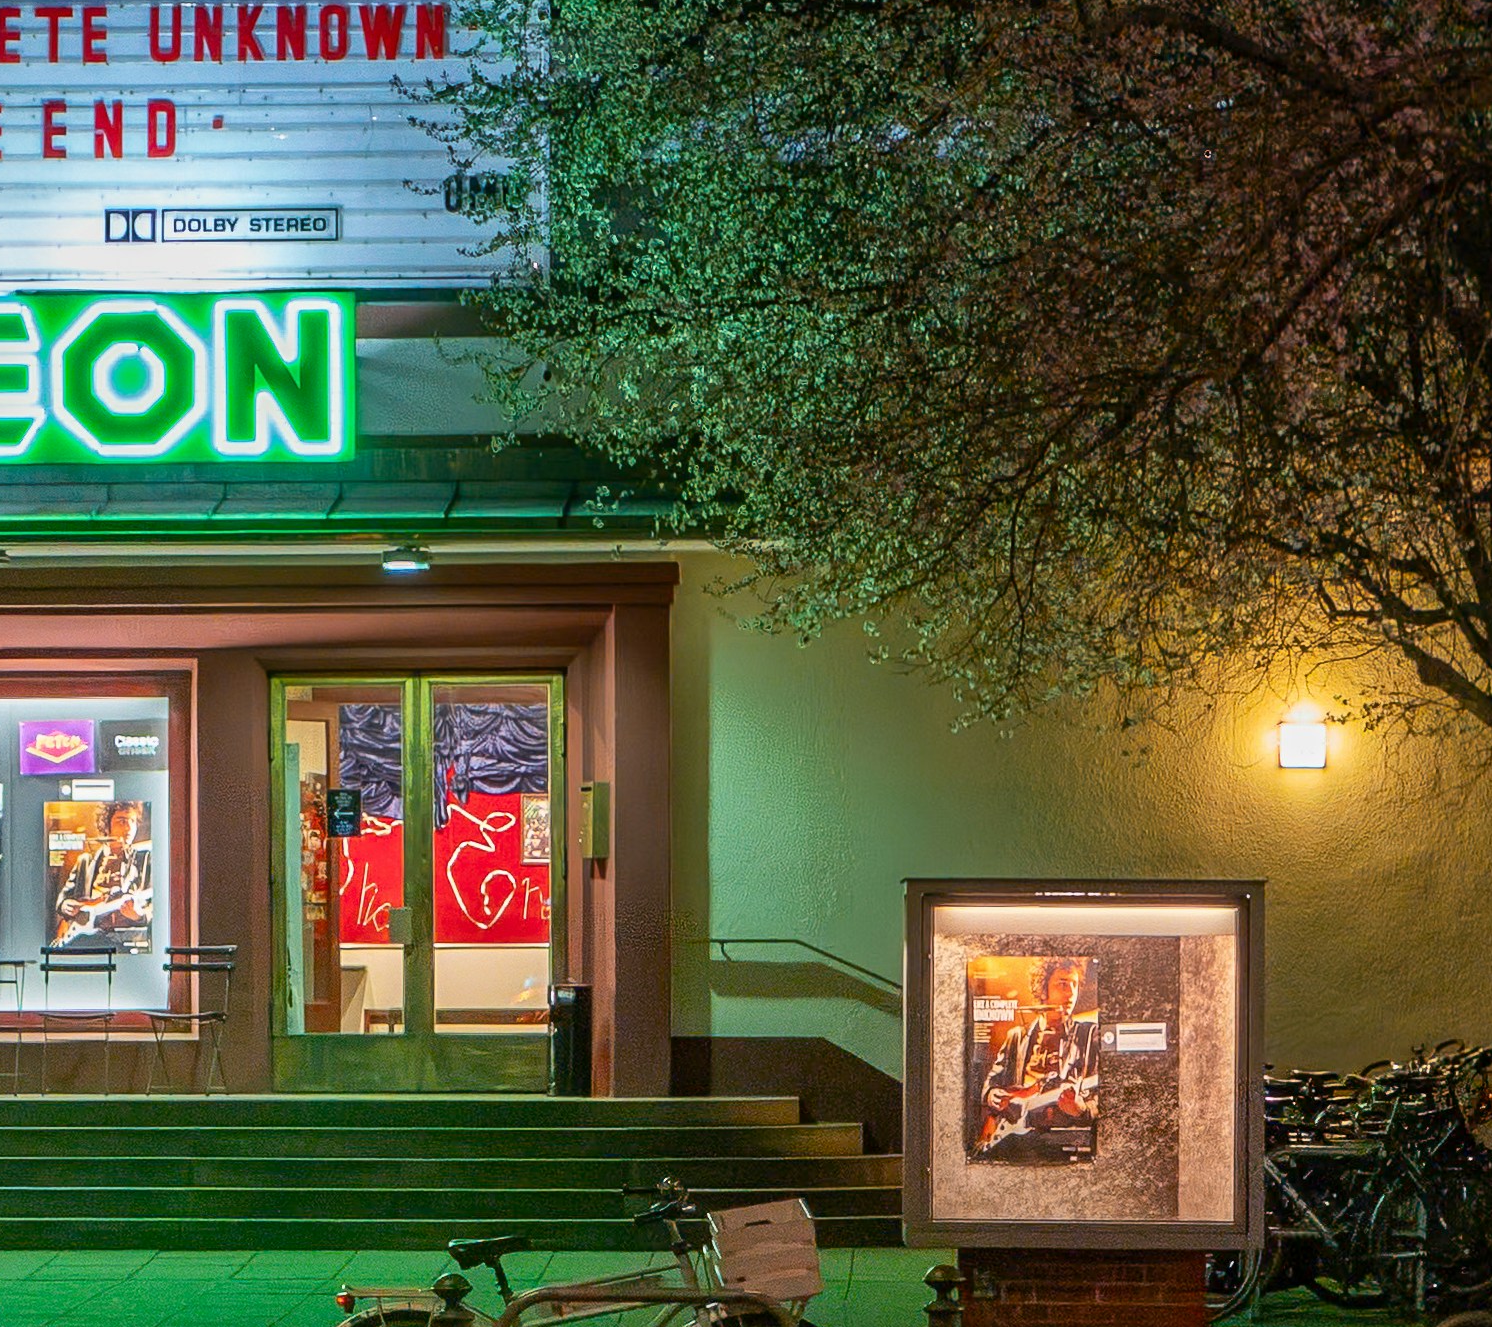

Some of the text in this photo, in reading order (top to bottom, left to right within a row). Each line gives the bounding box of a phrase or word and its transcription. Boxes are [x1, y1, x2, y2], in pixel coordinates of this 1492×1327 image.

[149, 2, 446, 62] UNKNOWN
[42, 98, 177, 159] END
[173, 216, 328, 234] DOLBY STEREO
